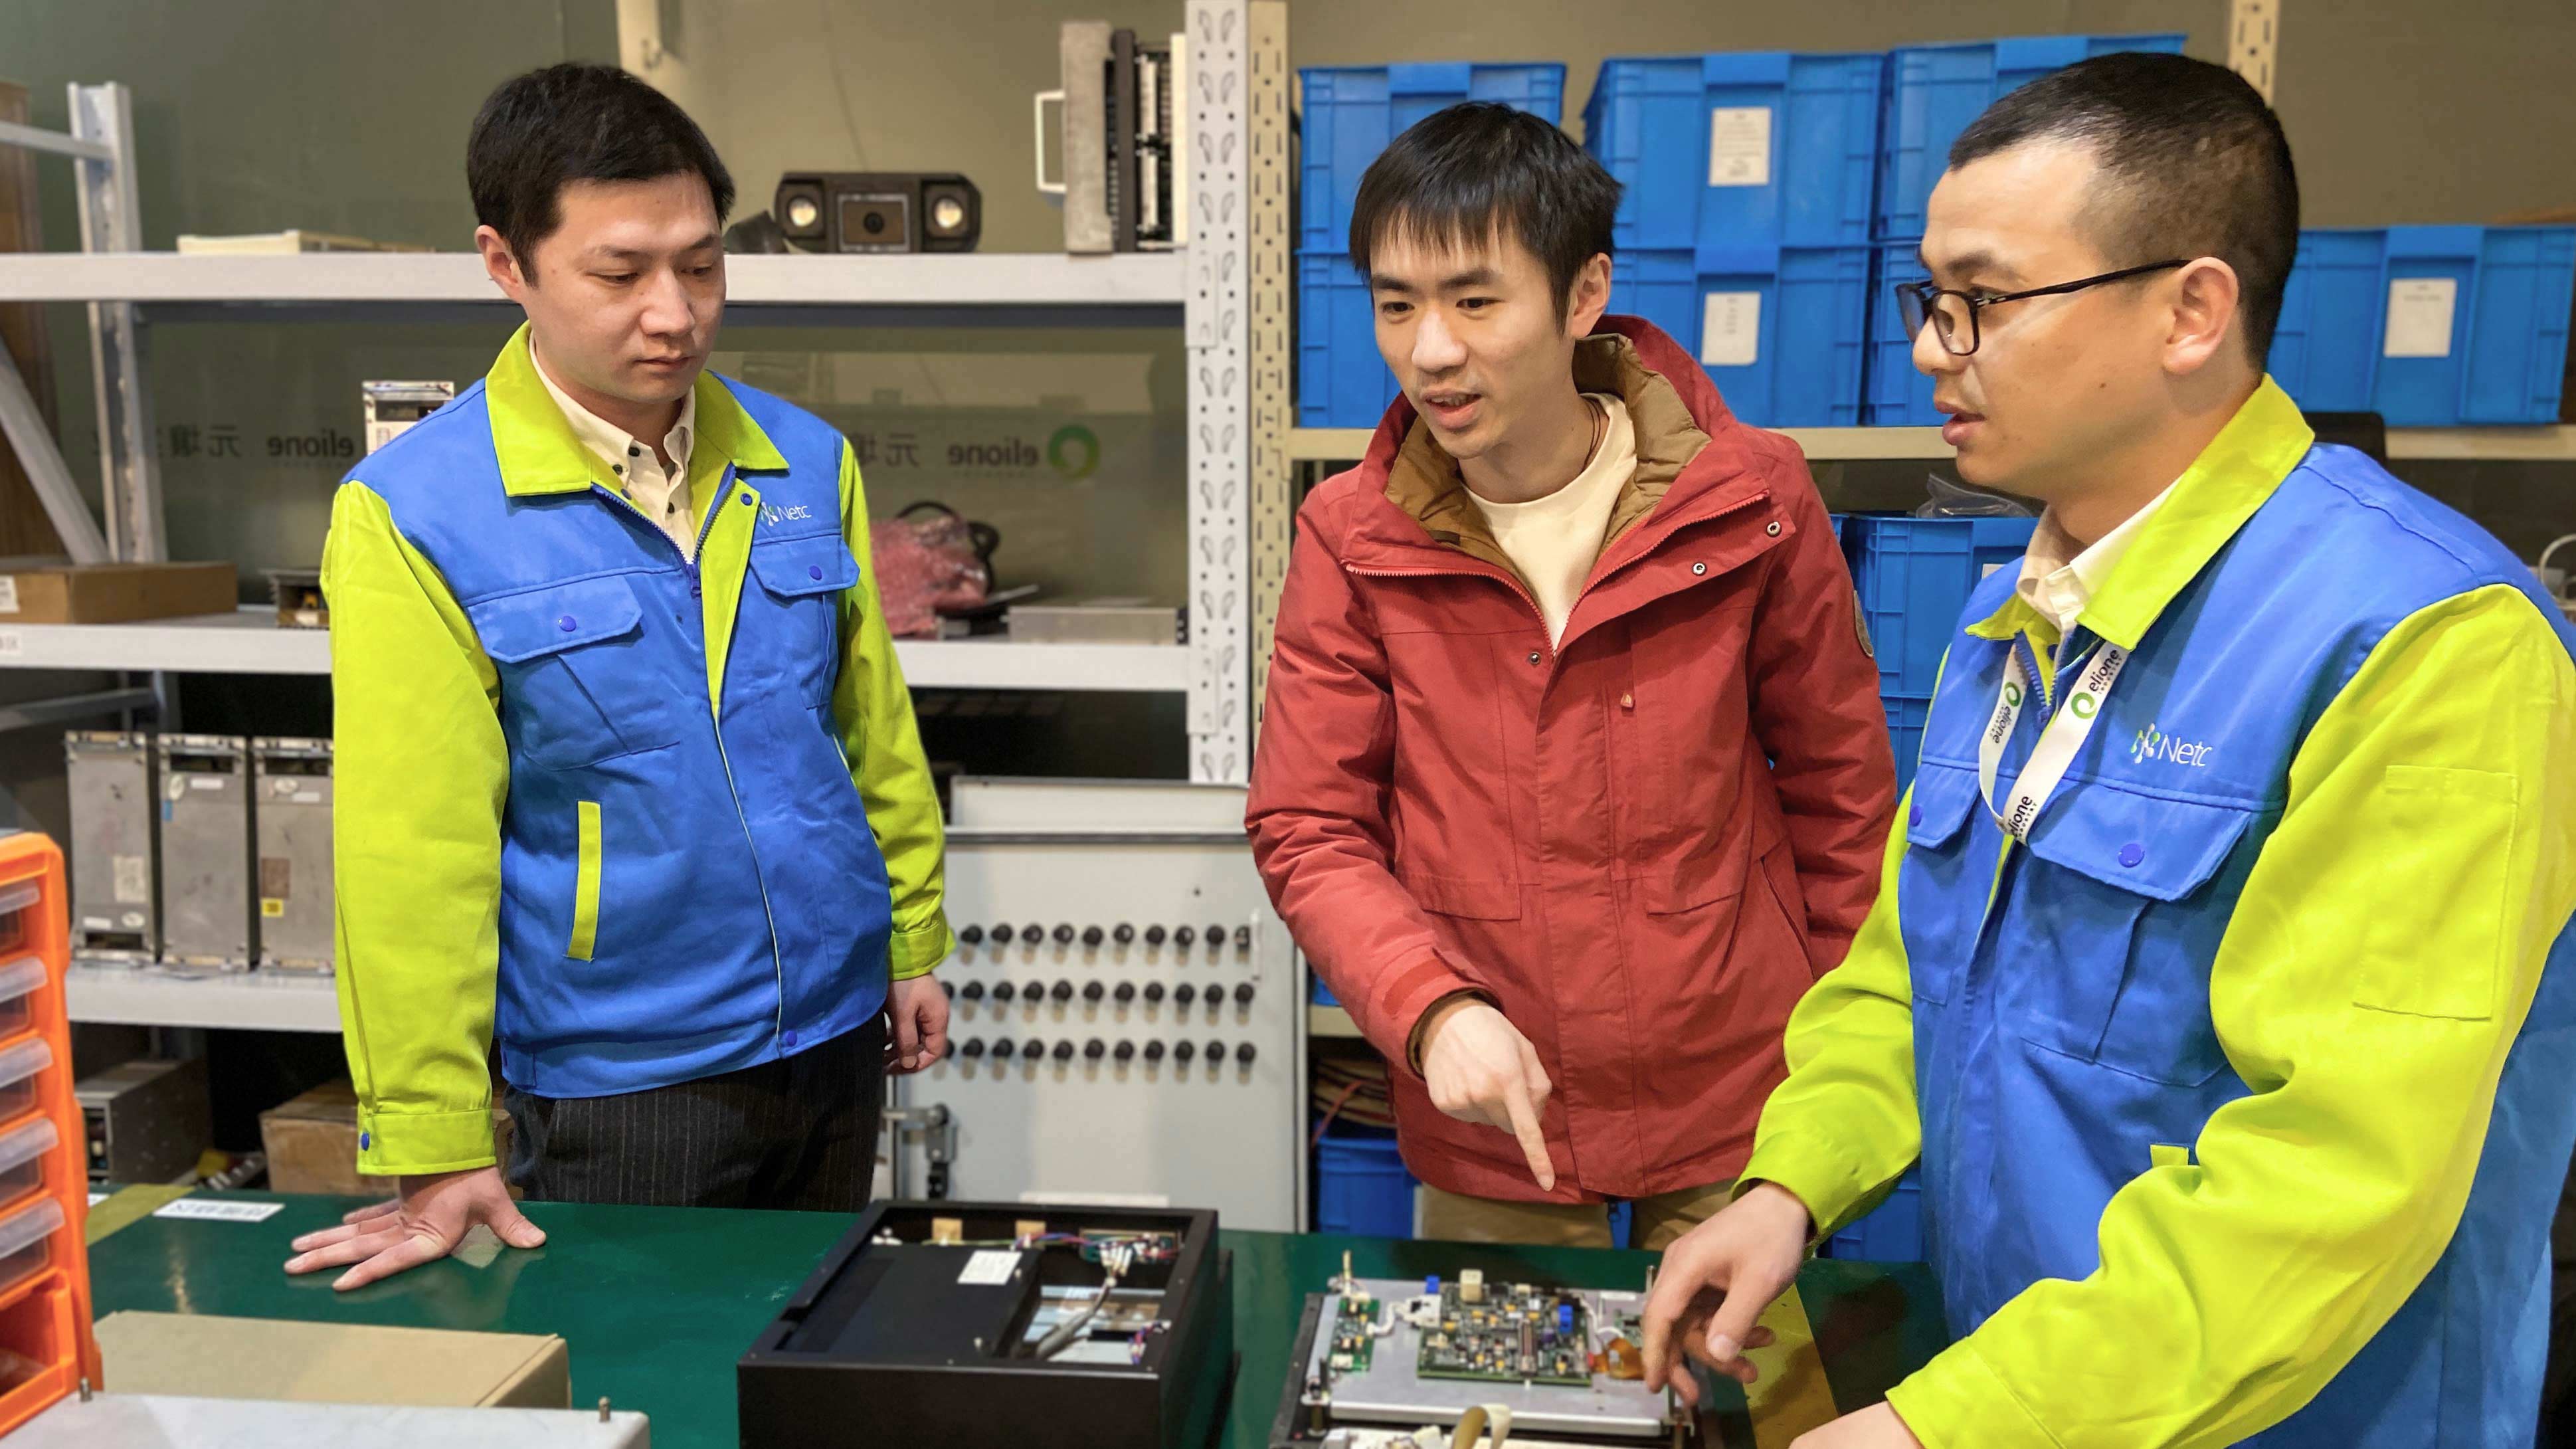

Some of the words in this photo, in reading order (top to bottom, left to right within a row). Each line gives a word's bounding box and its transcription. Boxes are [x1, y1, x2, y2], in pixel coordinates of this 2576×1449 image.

[777, 505, 812, 521] Netc
[2089, 648, 2120, 692] elione
[1993, 705, 2012, 744] elione
[2157, 733, 2213, 767] Netc
